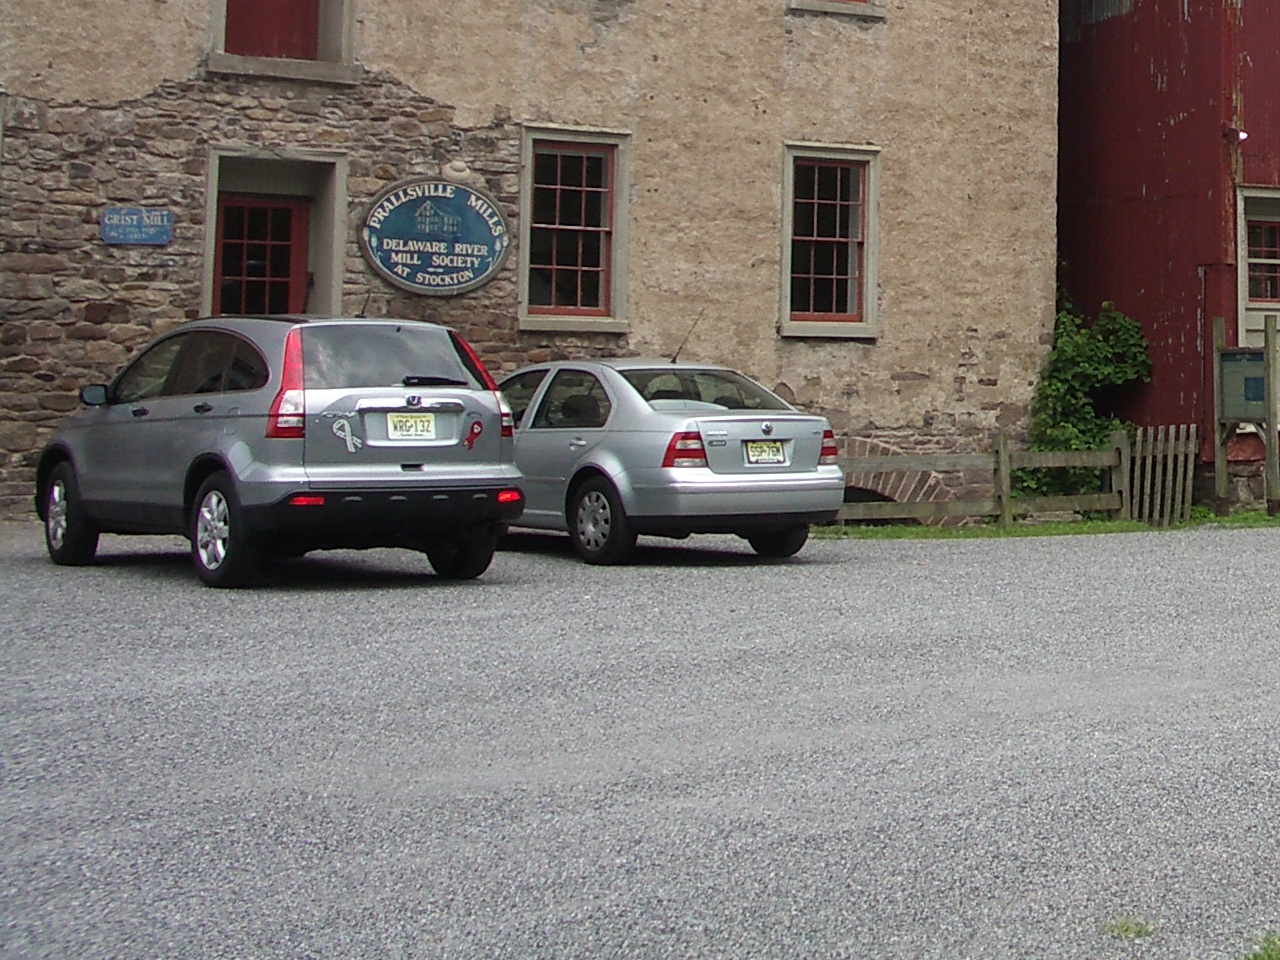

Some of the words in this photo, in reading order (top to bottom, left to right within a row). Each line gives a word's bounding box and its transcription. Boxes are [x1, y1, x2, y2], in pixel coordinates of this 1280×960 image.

[369, 184, 456, 230] PRALLSVILLE
[466, 194, 504, 236] MILLS
[104, 214, 138, 225] GRIST
[383, 238, 448, 253] DELAWARE
[454, 243, 489, 256] RIVER
[390, 252, 422, 265] MILL
[431, 255, 481, 268] SOCIETY
[393, 264, 411, 278] AT
[415, 269, 475, 286] STOCKTON
